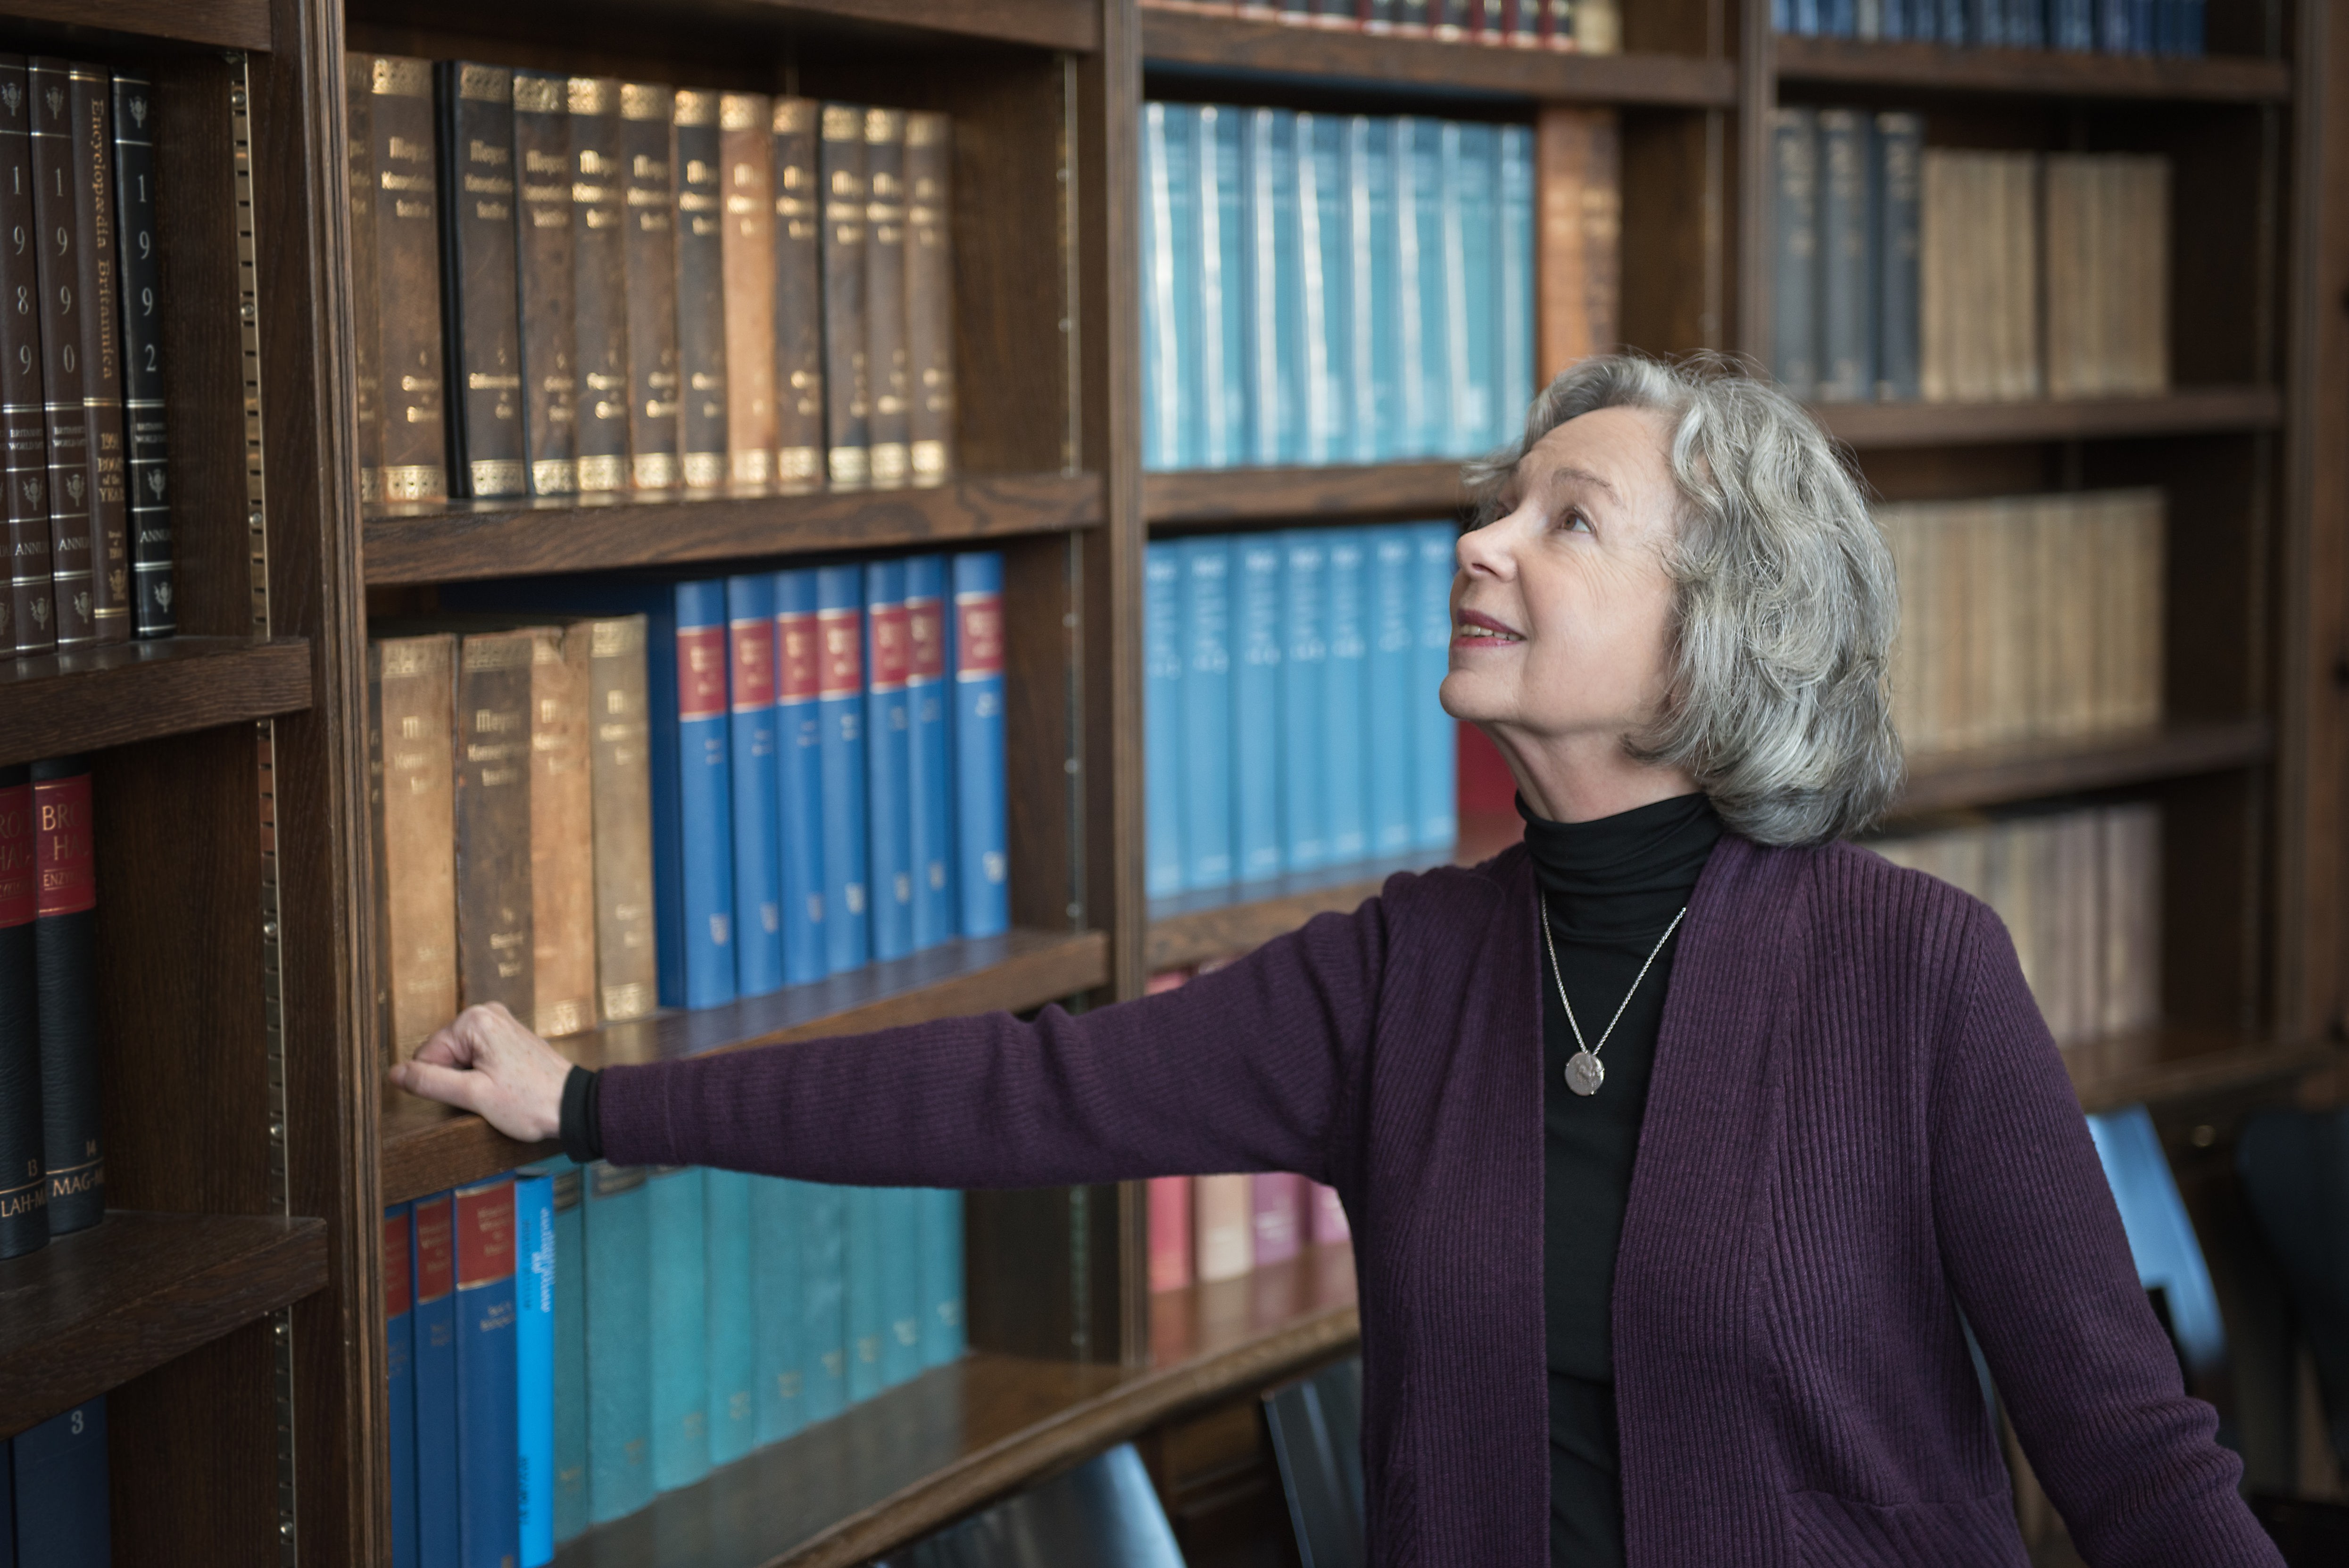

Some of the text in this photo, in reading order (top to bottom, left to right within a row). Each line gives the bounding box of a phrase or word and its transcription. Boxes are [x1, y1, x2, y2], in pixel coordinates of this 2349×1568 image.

[97, 259, 114, 379] Britannica
[8, 442, 34, 451] WORLD
[71, 1410, 84, 1435] 3
